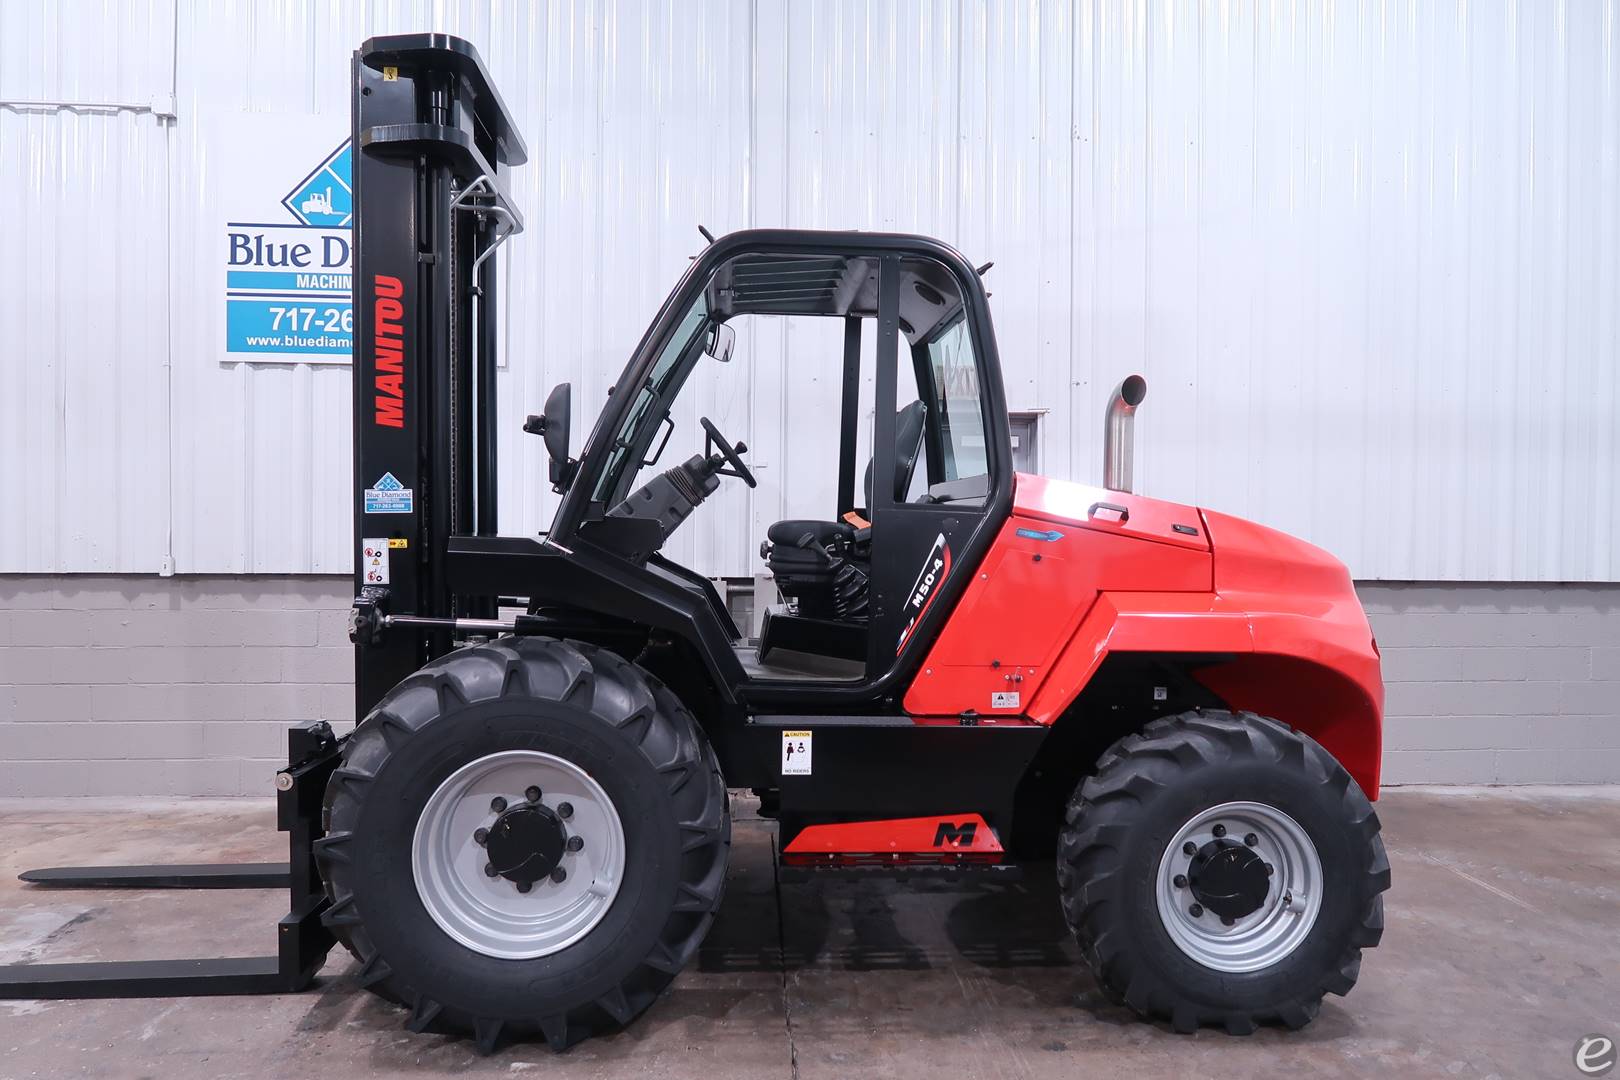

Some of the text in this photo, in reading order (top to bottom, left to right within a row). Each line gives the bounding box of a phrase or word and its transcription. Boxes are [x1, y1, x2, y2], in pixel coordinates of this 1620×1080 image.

[227, 233, 352, 268] Blue D
[269, 307, 353, 333] 717-26
[246, 335, 353, 348] www.bluediam
[375, 274, 404, 428] MANITOU
[912, 558, 943, 608] M50-4
